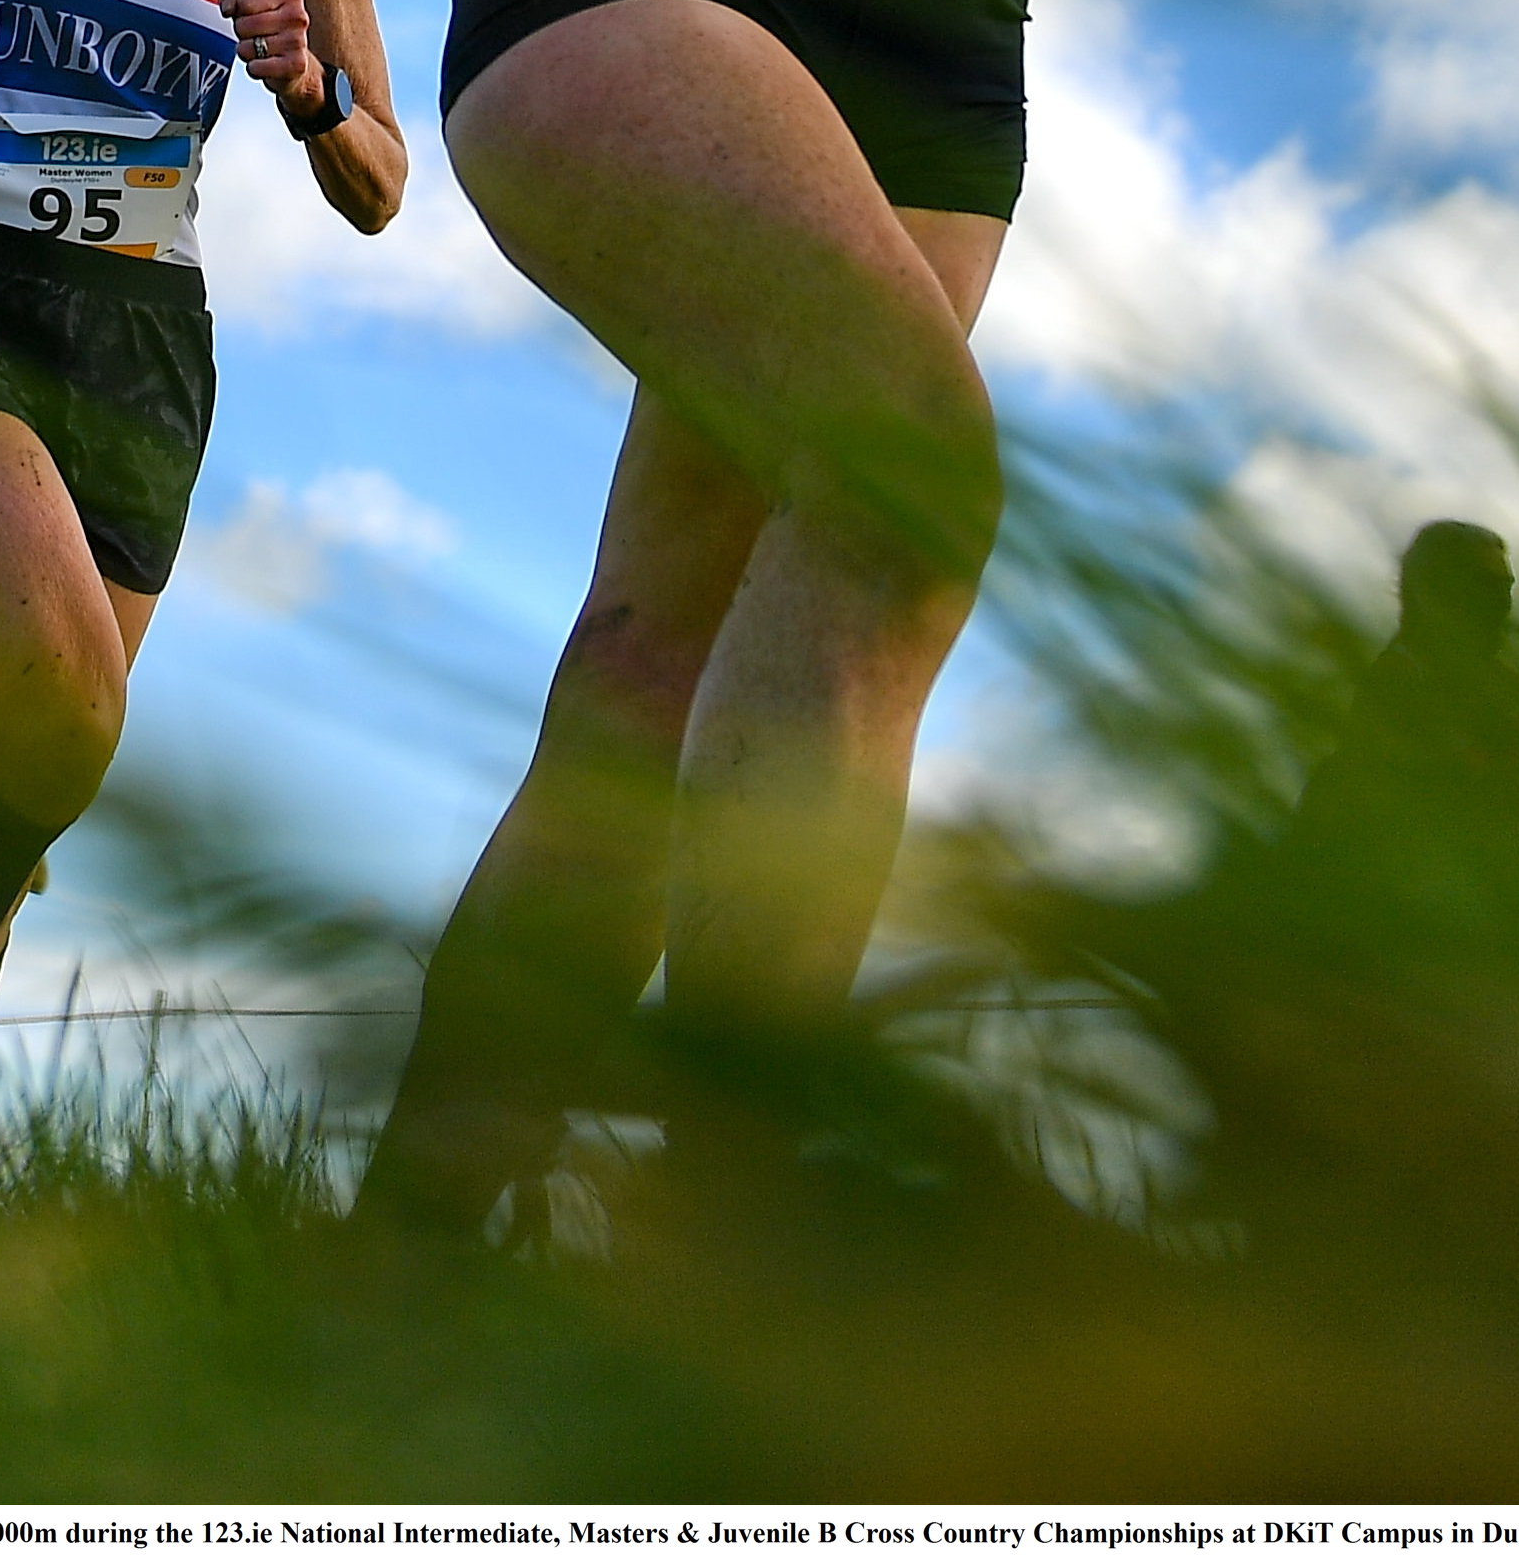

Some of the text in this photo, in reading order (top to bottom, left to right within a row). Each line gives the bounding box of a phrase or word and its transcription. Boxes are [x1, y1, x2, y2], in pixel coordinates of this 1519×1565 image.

[40, 135, 118, 163] 123.ie
[38, 167, 113, 178] Master Women
[142, 172, 166, 183] F50
[28, 186, 123, 243] 95
